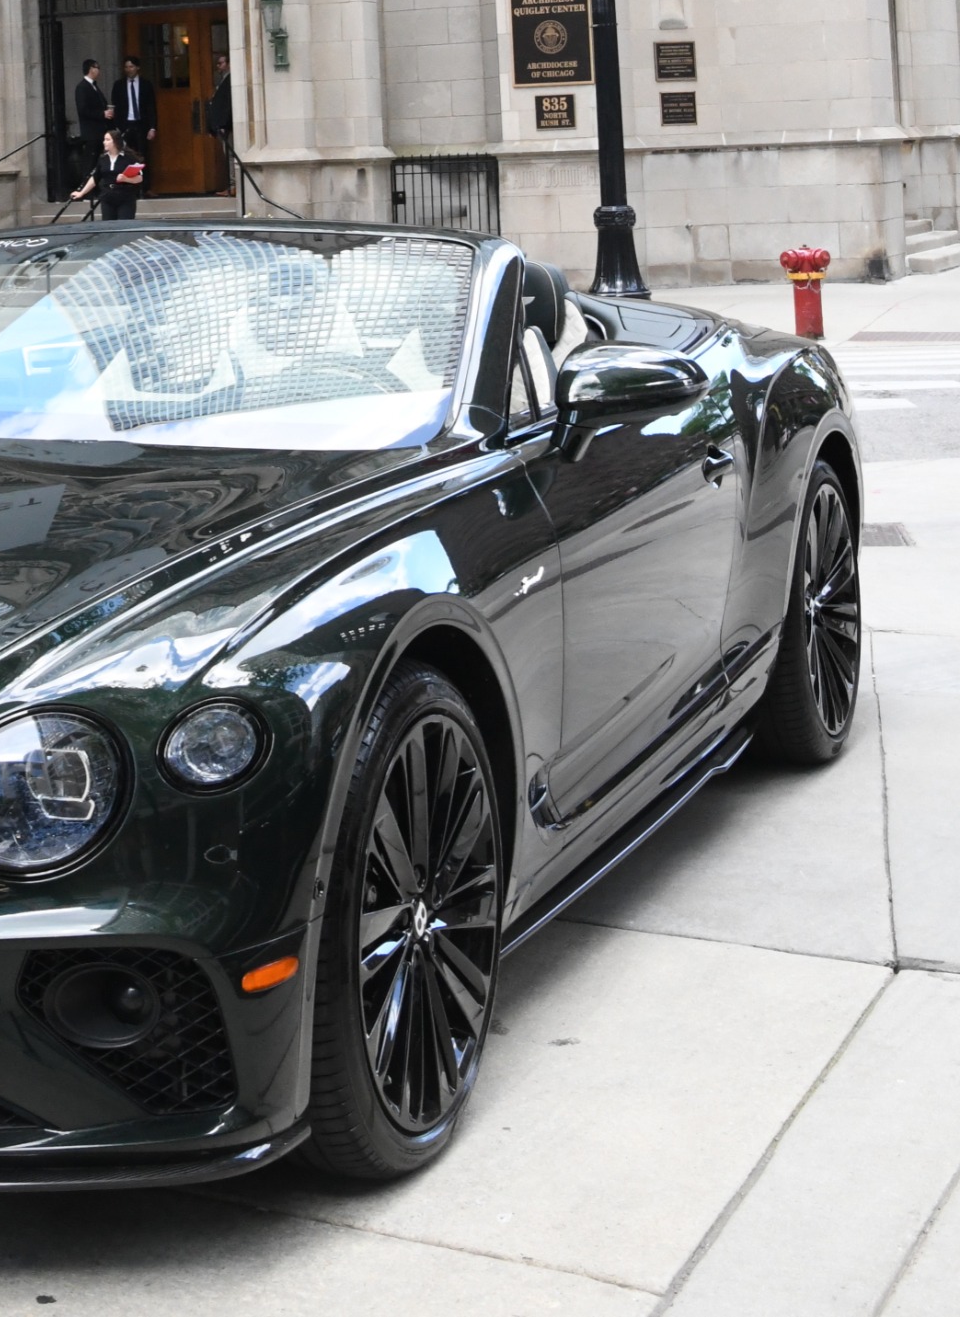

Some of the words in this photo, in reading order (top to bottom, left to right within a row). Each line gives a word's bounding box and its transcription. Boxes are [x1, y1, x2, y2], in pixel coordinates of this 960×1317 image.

[513, 6, 550, 17] QUIGLEY
[552, 4, 586, 14] CENTER
[526, 61, 578, 70] ARCHDIOCESE
[542, 70, 575, 78] CHICAGO
[542, 97, 568, 111] 835
[540, 119, 559, 127] RUSH
